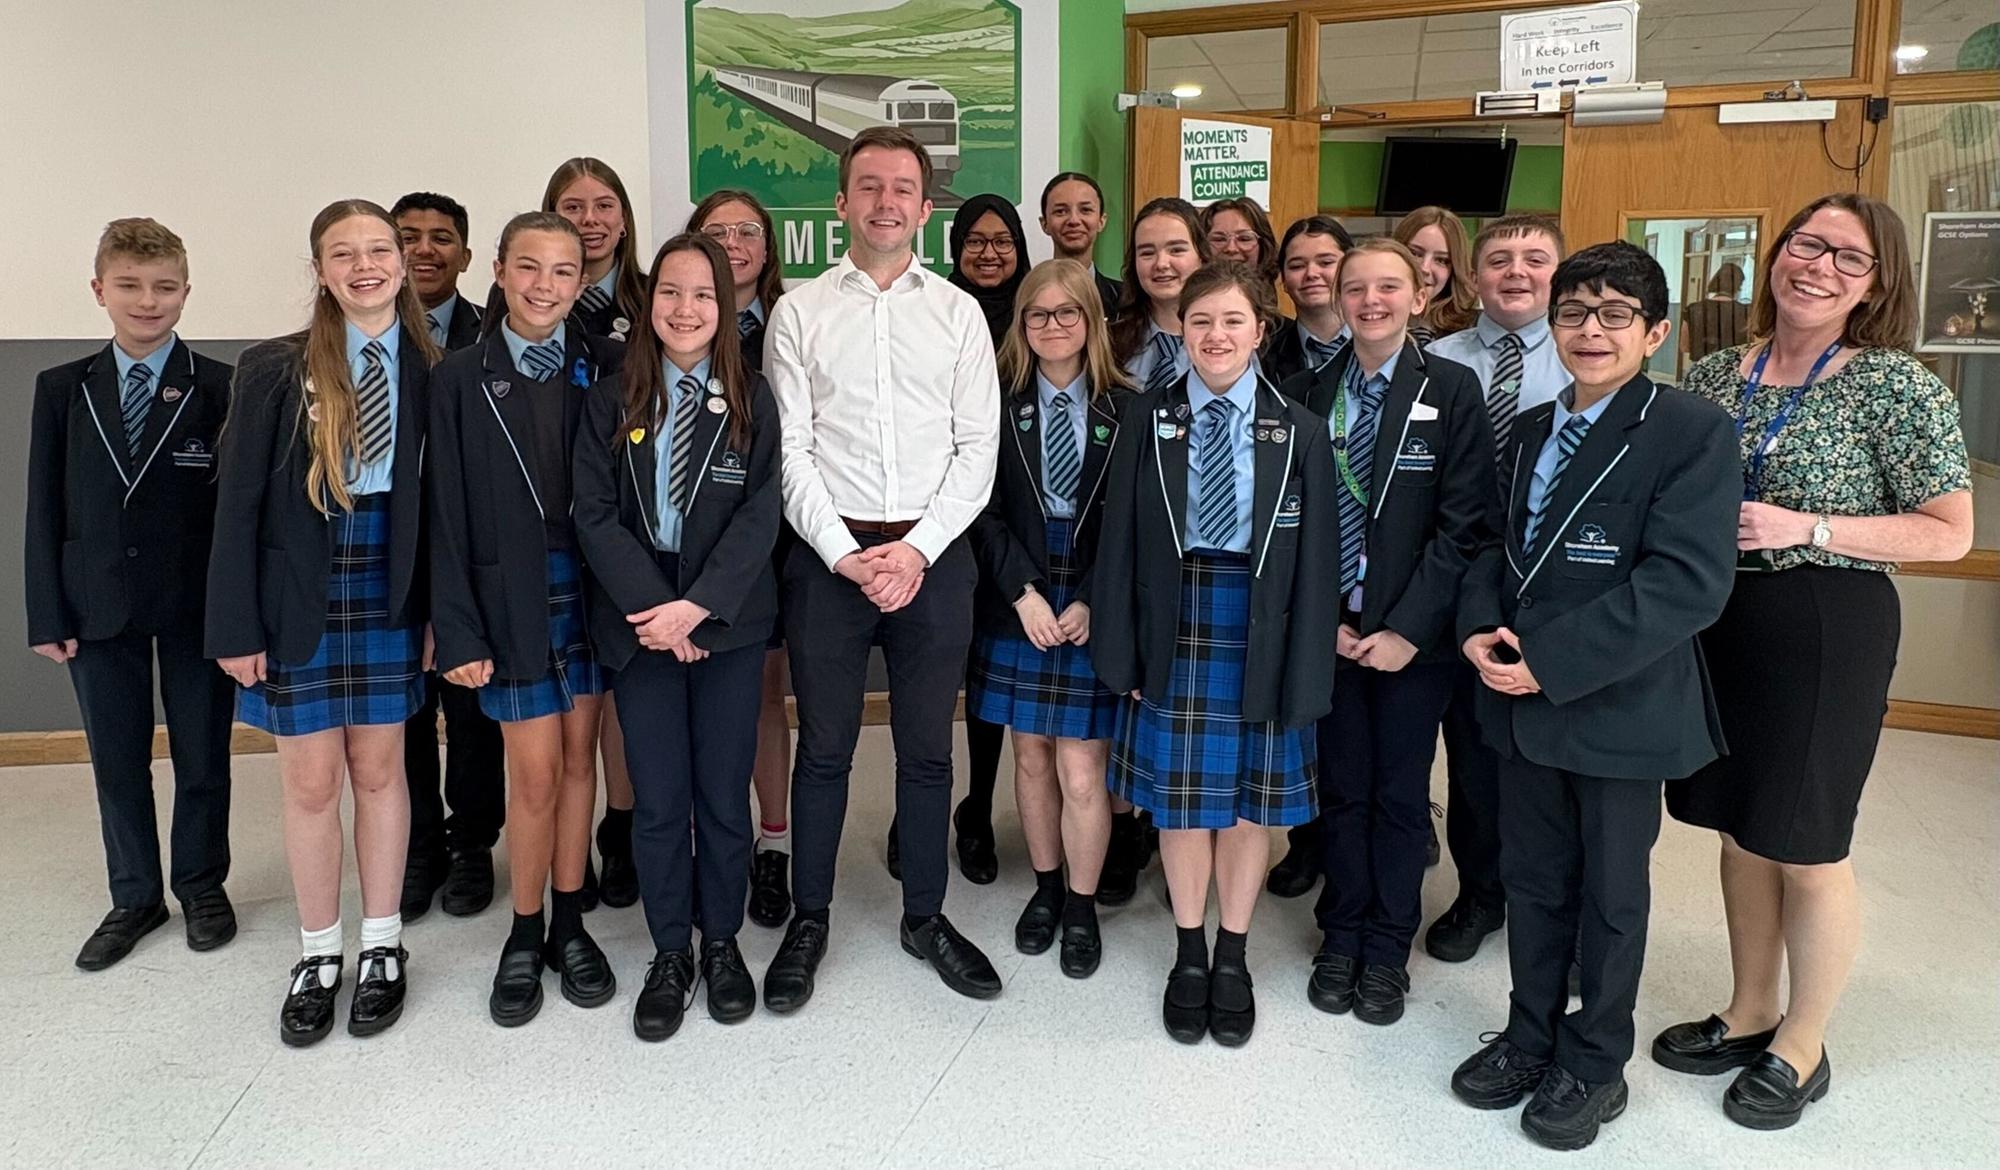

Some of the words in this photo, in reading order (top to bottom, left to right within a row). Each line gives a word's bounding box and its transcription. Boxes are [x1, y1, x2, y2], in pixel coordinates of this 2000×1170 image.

[1536, 45, 1569, 58] Keep
[1574, 40, 1600, 54] Left
[1536, 65, 1555, 76] the
[1558, 59, 1614, 74] Corridors
[1183, 129, 1248, 145] MOMENTS
[1184, 146, 1240, 161] MATTER,
[1194, 165, 1265, 180] ATTENDANCE
[1194, 181, 1243, 197] COUNTS.
